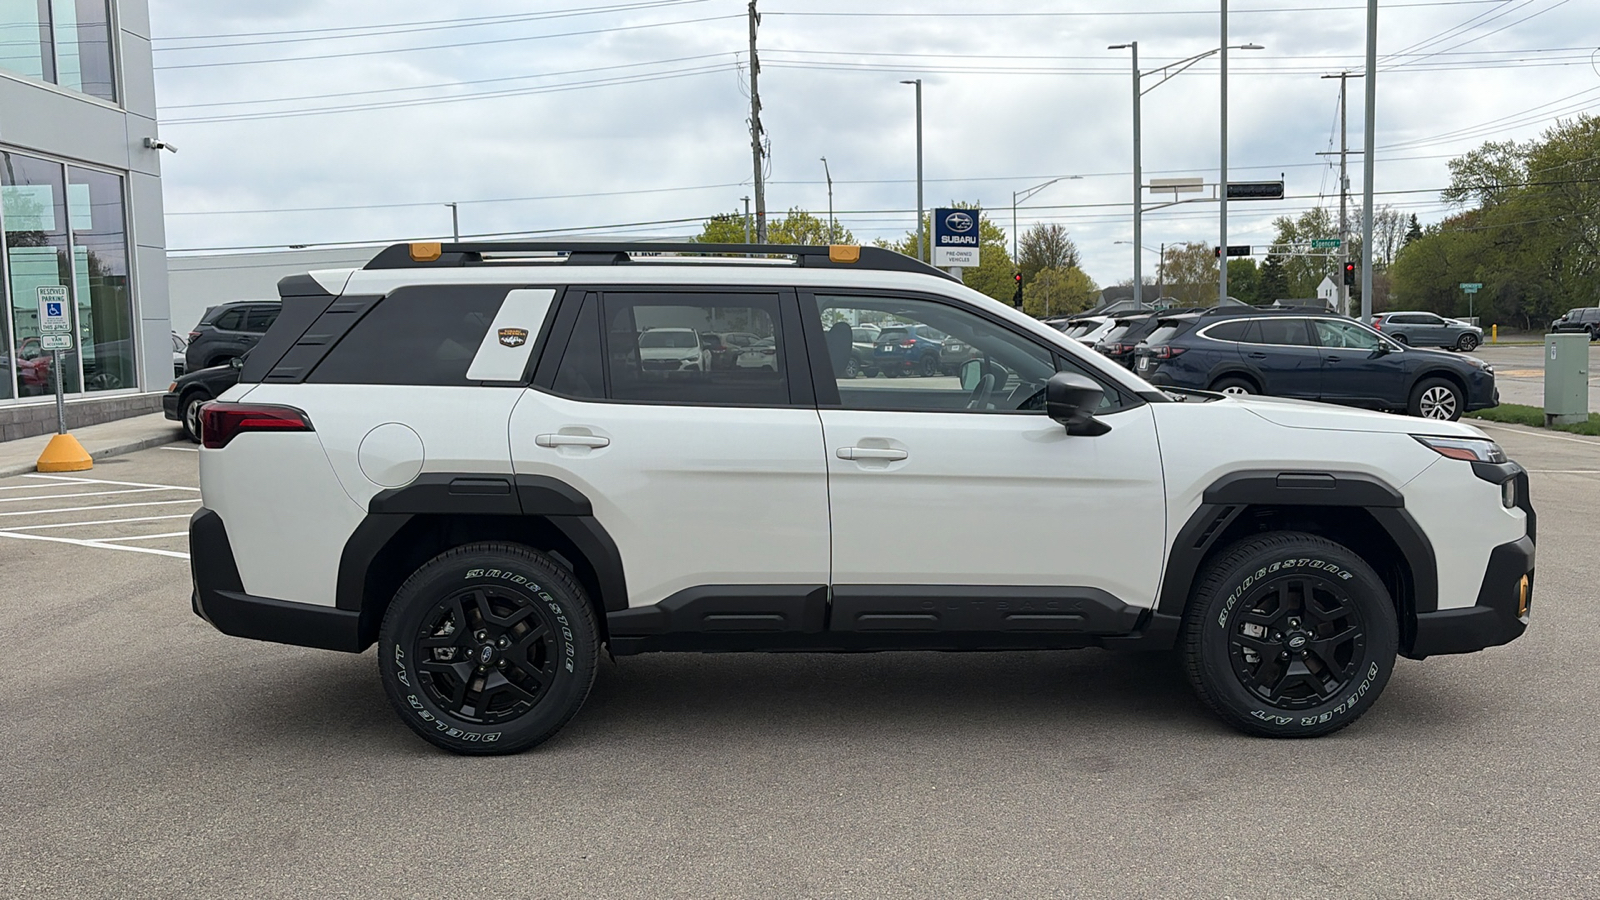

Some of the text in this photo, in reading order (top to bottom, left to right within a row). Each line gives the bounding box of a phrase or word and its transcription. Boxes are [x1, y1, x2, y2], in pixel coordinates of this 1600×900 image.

[941, 235, 976, 244] SUBARU
[1316, 240, 1336, 248] Spencer
[465, 568, 576, 673] BRIDGESTONE
[920, 601, 1083, 610] OUTBACK
[1217, 558, 1354, 629] BRIDGESTONE
[395, 644, 502, 743] DUELER A/T
[1251, 661, 1379, 726] DUELER A/T
